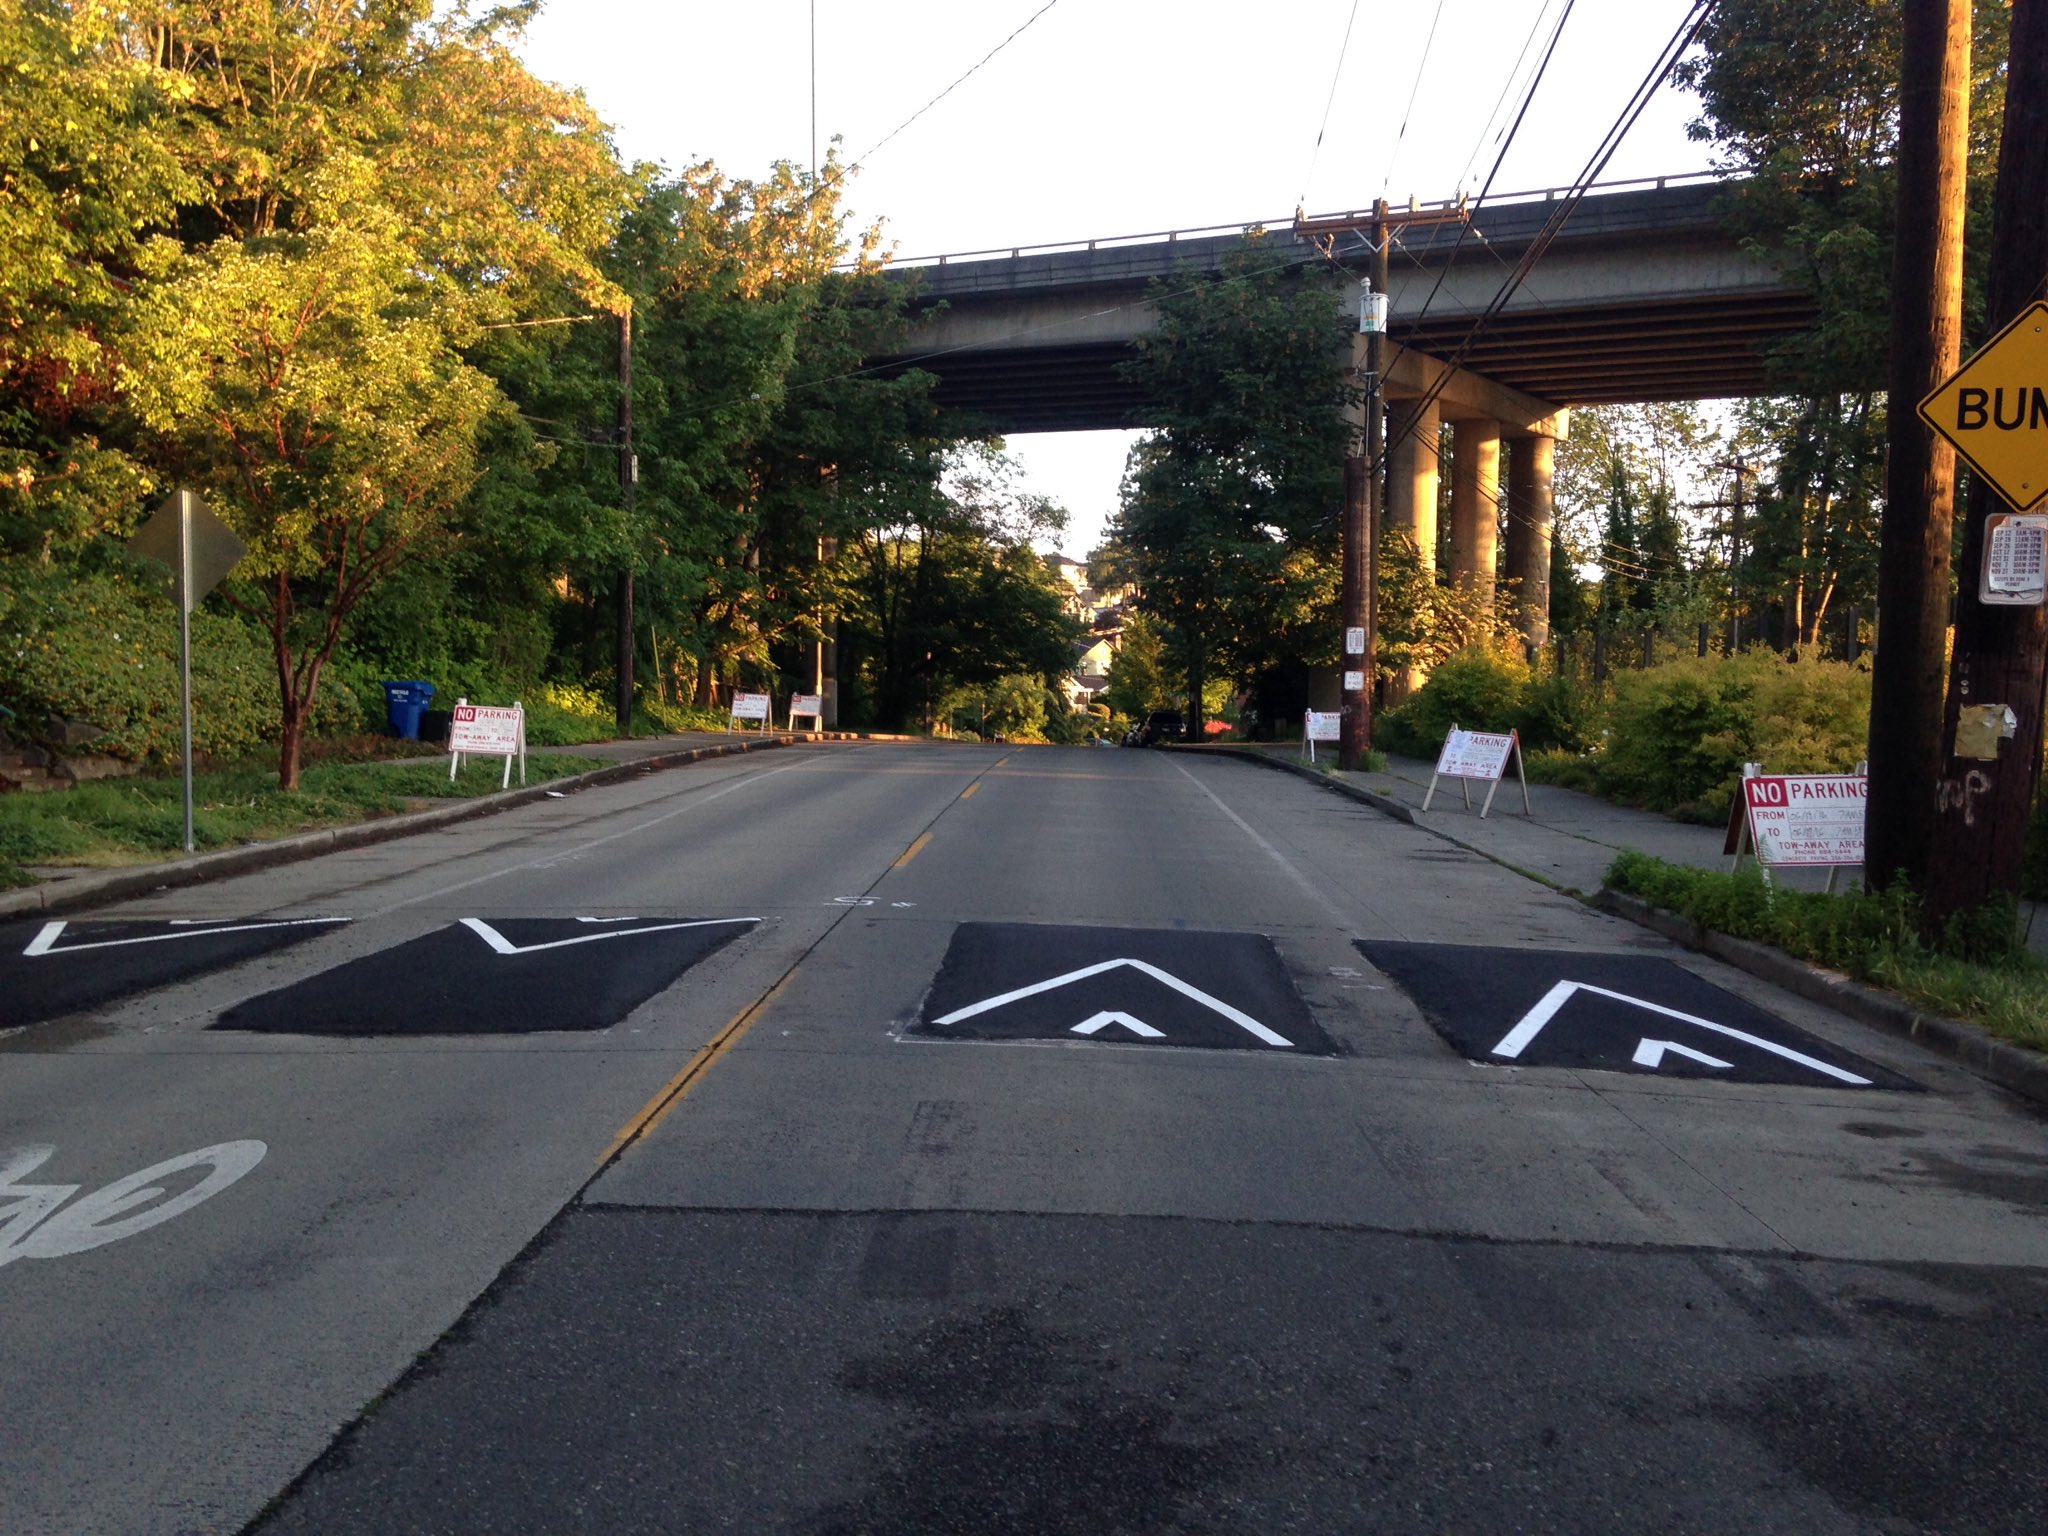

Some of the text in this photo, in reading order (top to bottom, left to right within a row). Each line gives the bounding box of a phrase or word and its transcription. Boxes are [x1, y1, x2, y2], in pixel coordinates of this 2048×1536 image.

[457, 708, 518, 721] NO PARKING
[1752, 782, 1868, 803] NO PARKING
[1756, 811, 1785, 820] FROM
[1767, 827, 1780, 837] TO
[1778, 840, 1865, 850] TOW-AWAY AREA
